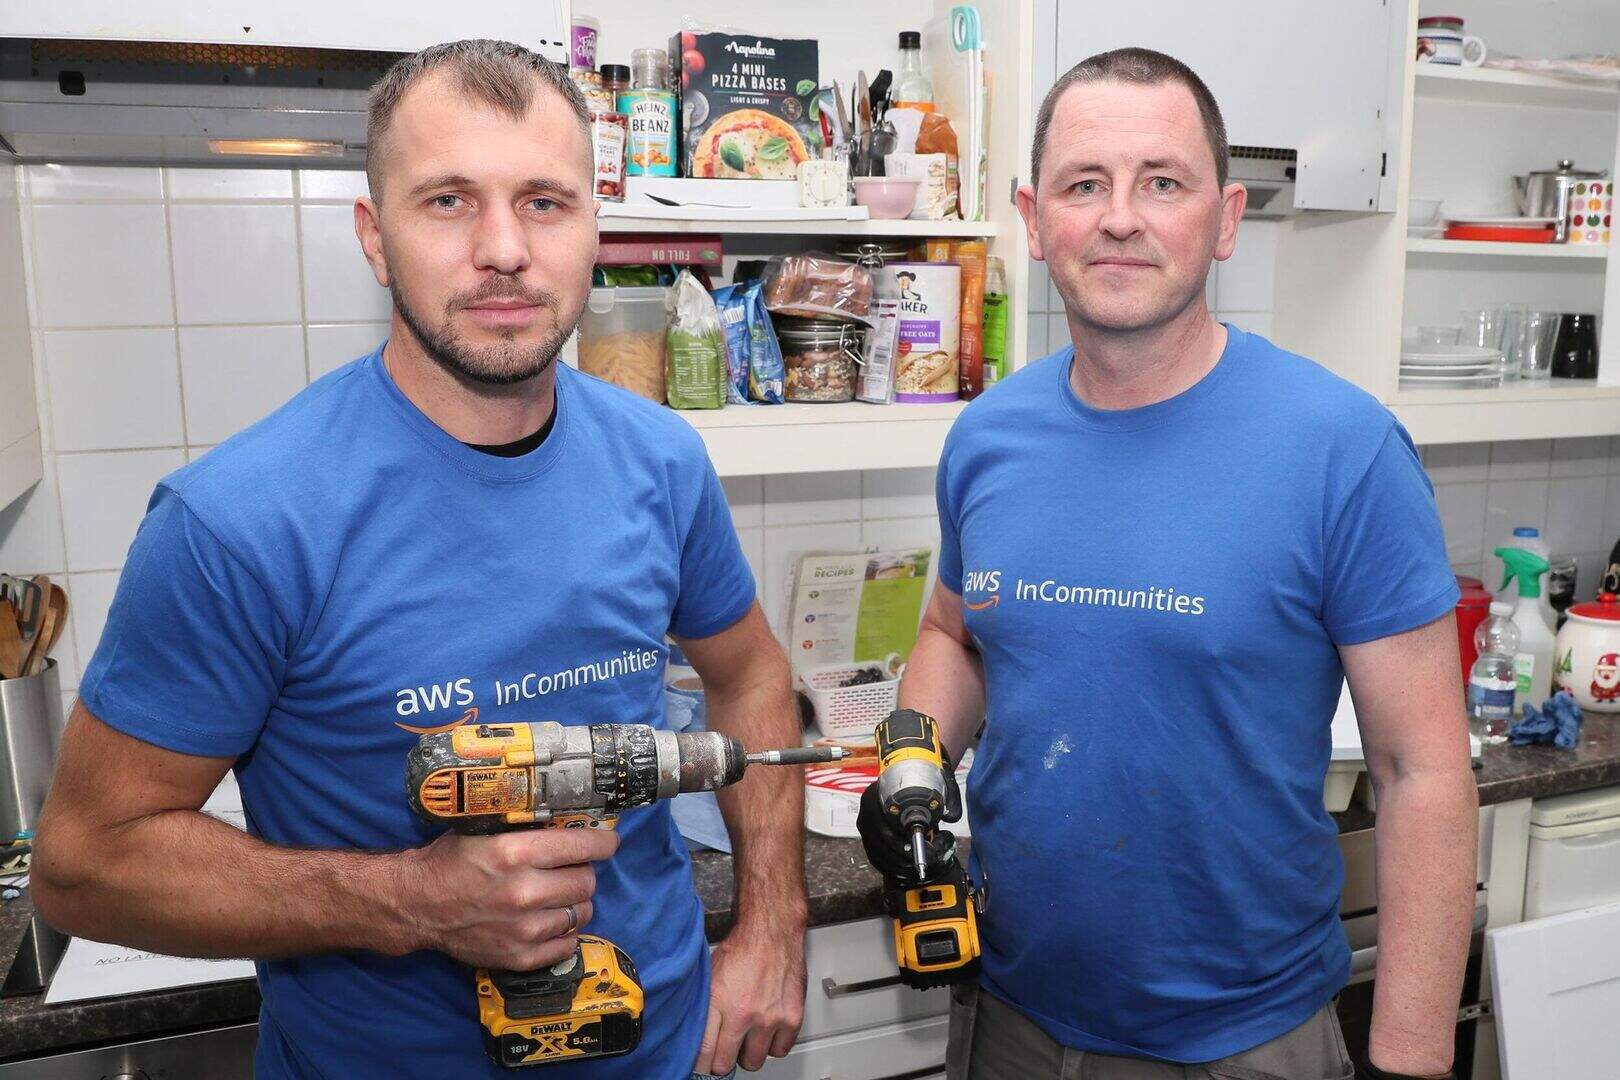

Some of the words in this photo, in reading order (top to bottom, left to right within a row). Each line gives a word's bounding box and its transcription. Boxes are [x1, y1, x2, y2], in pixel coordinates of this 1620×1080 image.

[725, 41, 776, 58] Napolina
[732, 63, 738, 74] 4
[742, 63, 765, 76] MINI
[712, 74, 746, 89] PIZZA
[751, 77, 786, 91] BASES
[633, 119, 669, 133] BEANZ
[965, 570, 1001, 592] aws
[1015, 578, 1205, 615] InCommunities
[395, 678, 474, 716] aws
[495, 647, 659, 706] InCommunities
[532, 1022, 572, 1035] DEWALT
[510, 1045, 529, 1054] 18V
